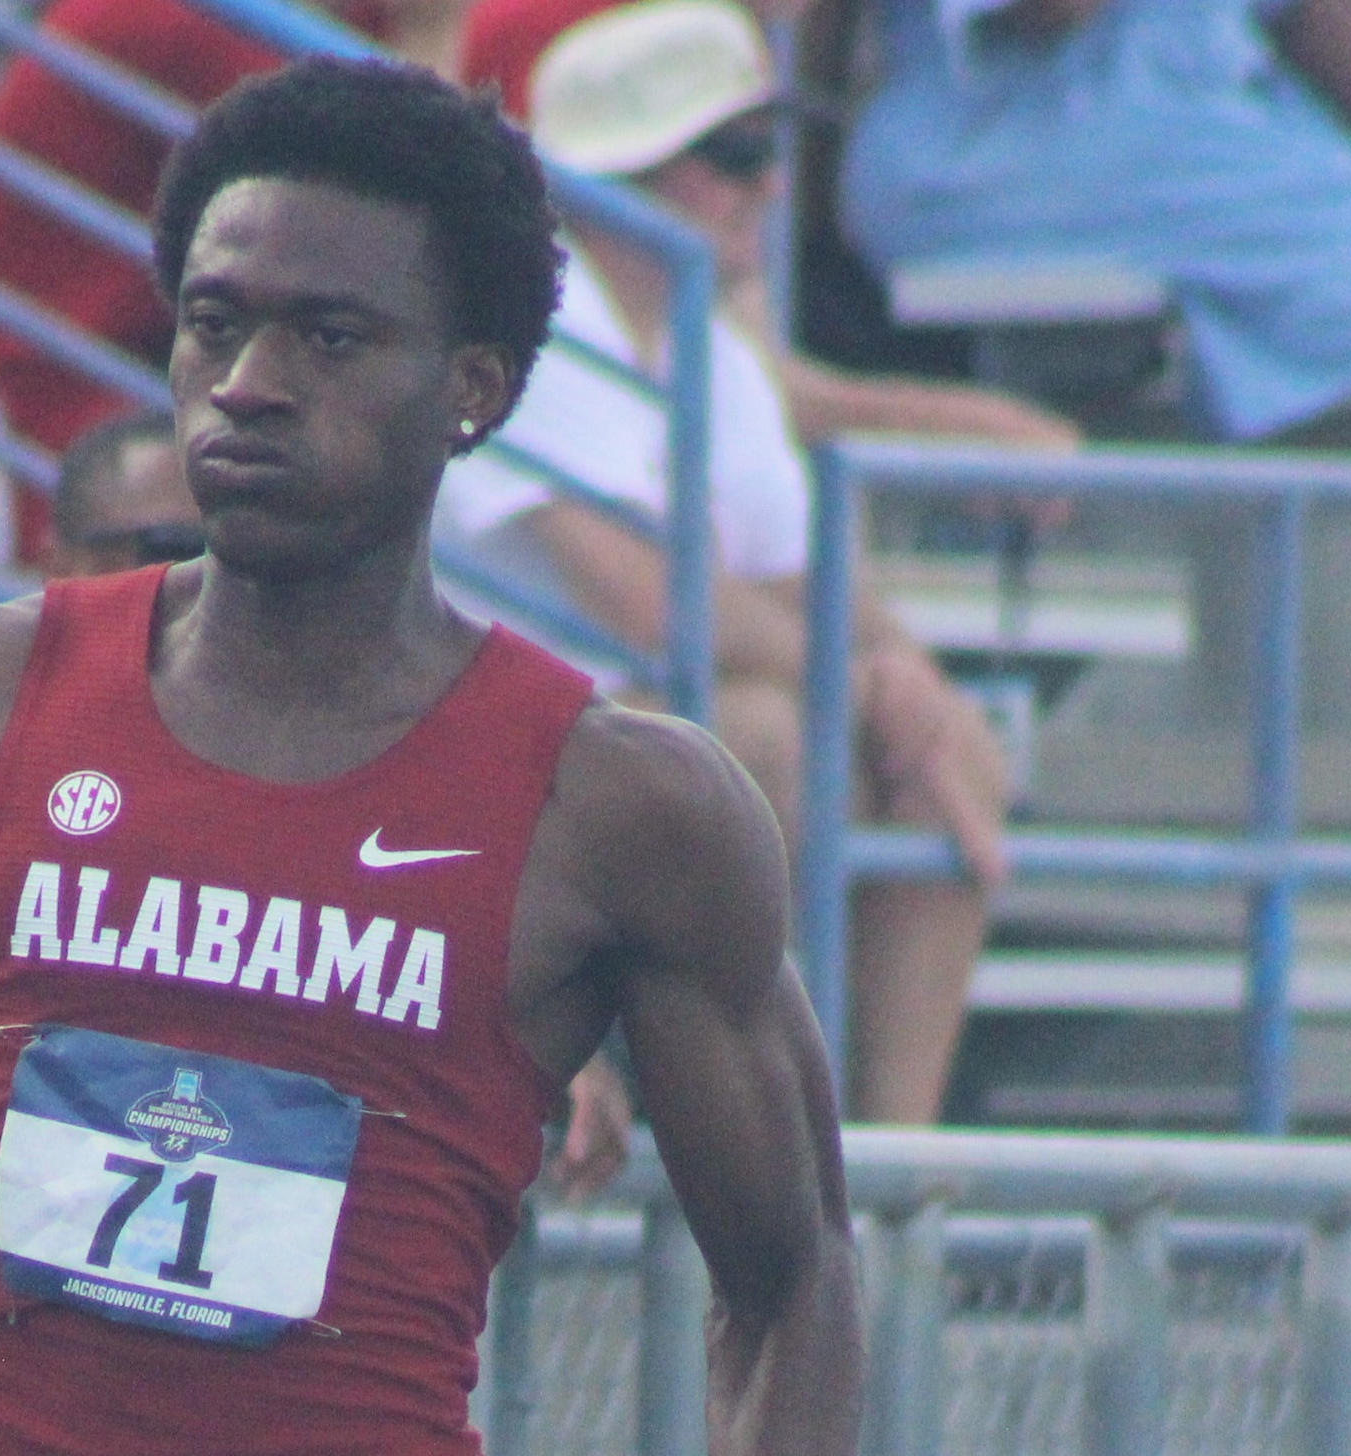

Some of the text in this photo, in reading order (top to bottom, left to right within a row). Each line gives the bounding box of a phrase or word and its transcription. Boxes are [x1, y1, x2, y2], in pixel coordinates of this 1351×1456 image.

[53, 774, 115, 830] SEC
[10, 861, 446, 1030] ALABAMA
[128, 1111, 229, 1141] CHAMPIONSHIPS
[86, 1152, 217, 1290] 71
[62, 1278, 233, 1329] JACKSONVILLE, FLORIDA
